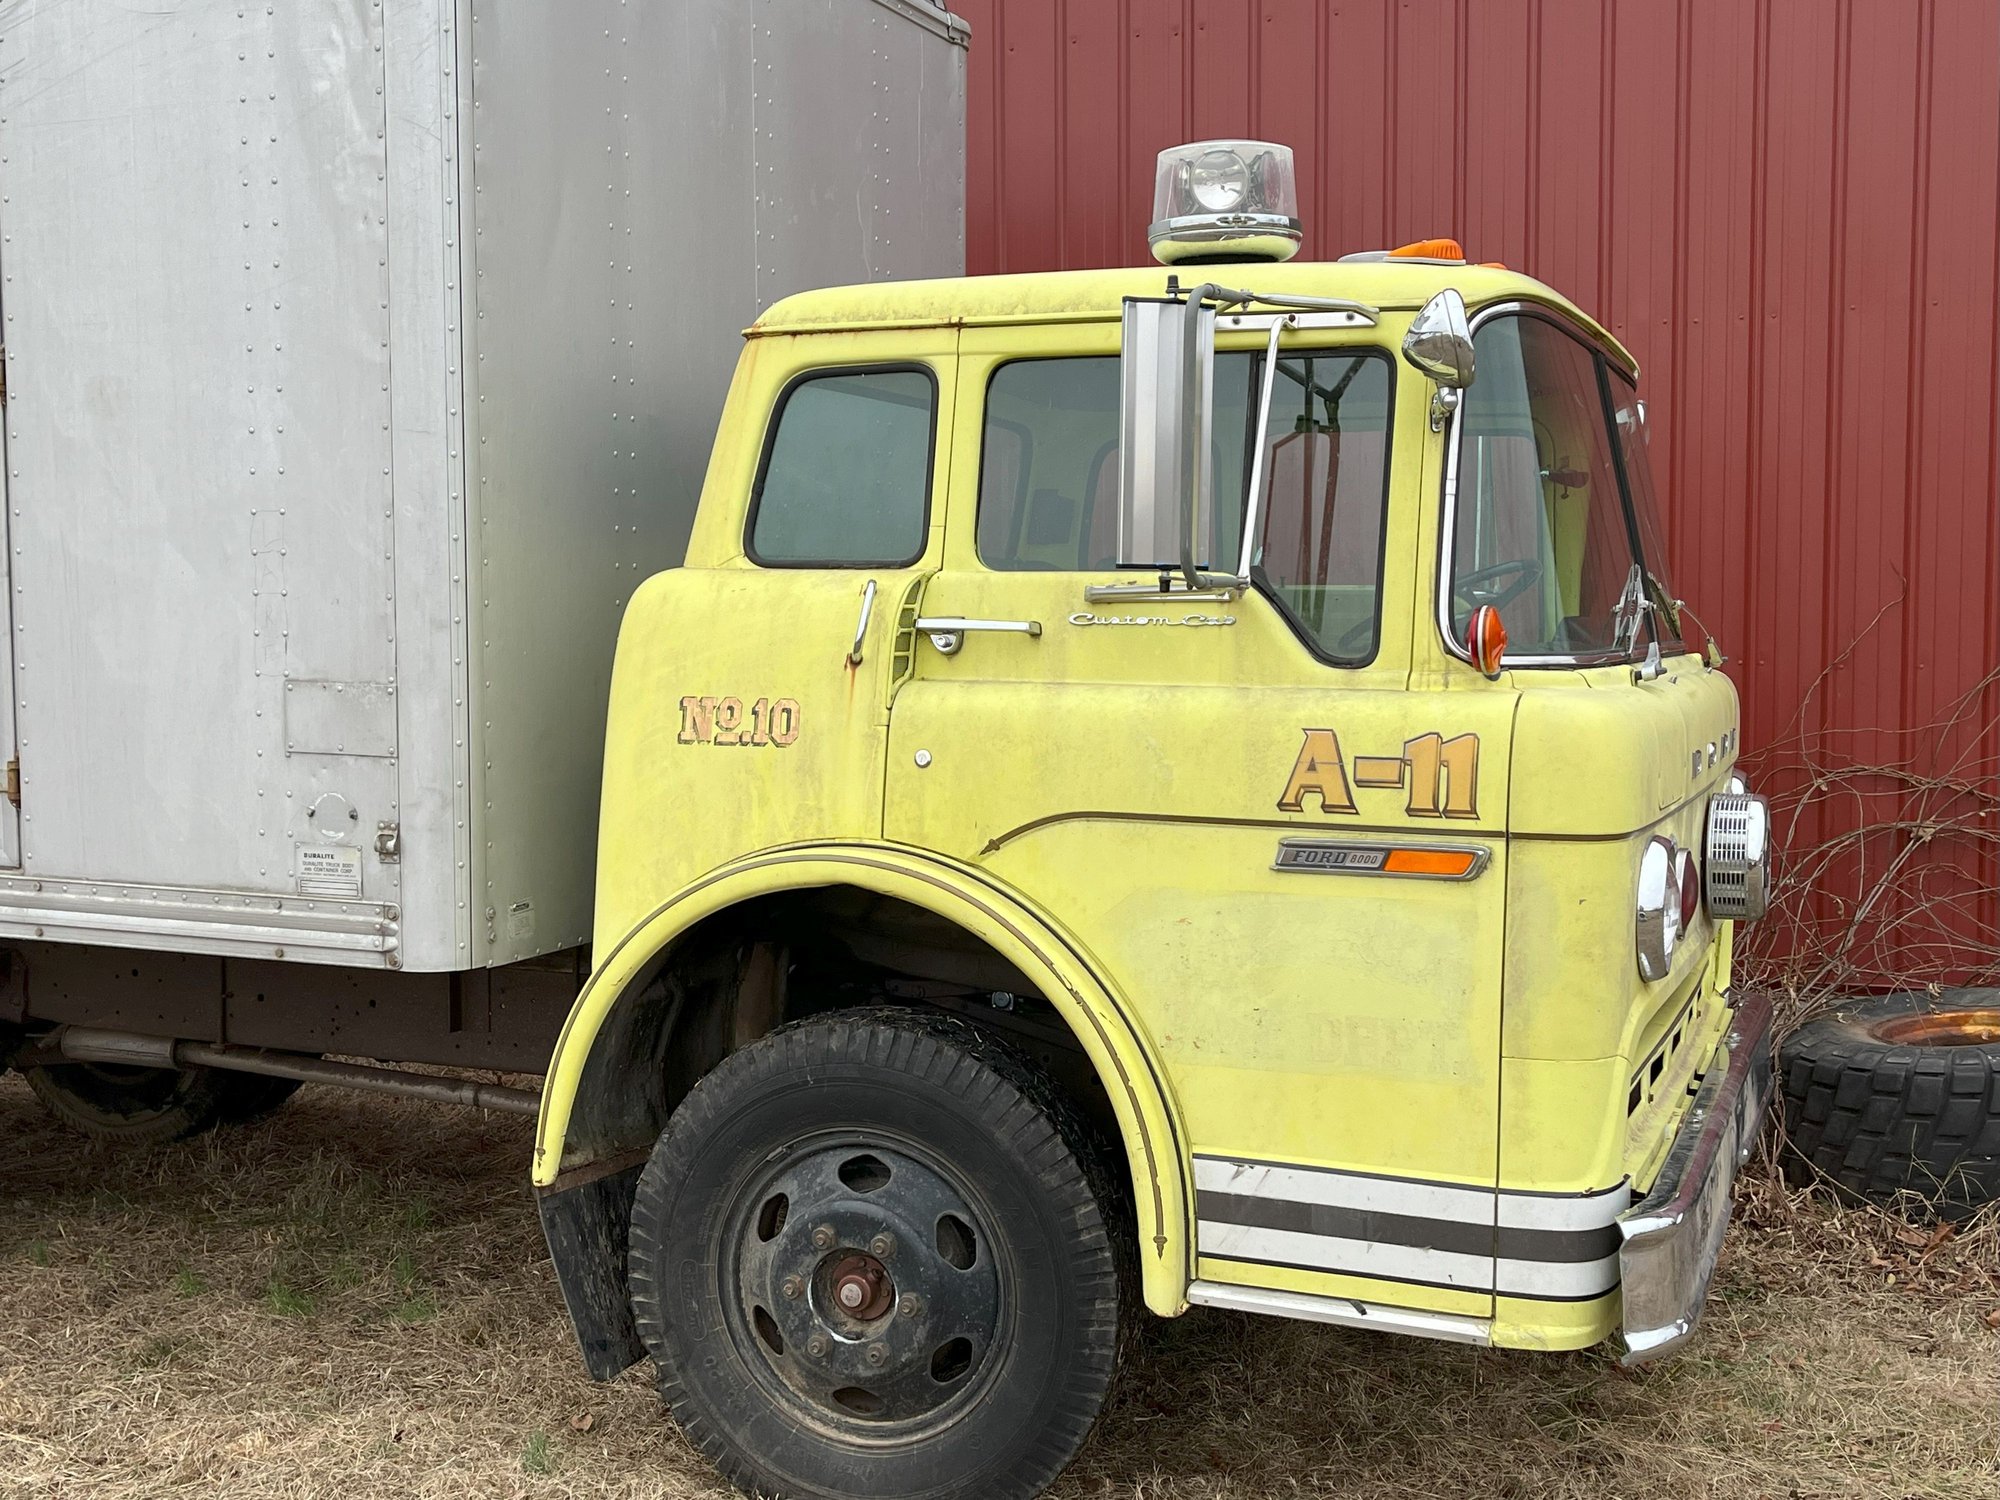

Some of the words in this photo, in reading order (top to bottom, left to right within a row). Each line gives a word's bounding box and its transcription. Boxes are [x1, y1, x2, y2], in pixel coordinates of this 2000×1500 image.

[1068, 612, 1179, 626] Custom
[1277, 728, 1480, 820] A-11
[1292, 850, 1347, 864] FORD
[1350, 854, 1377, 864] 8000
